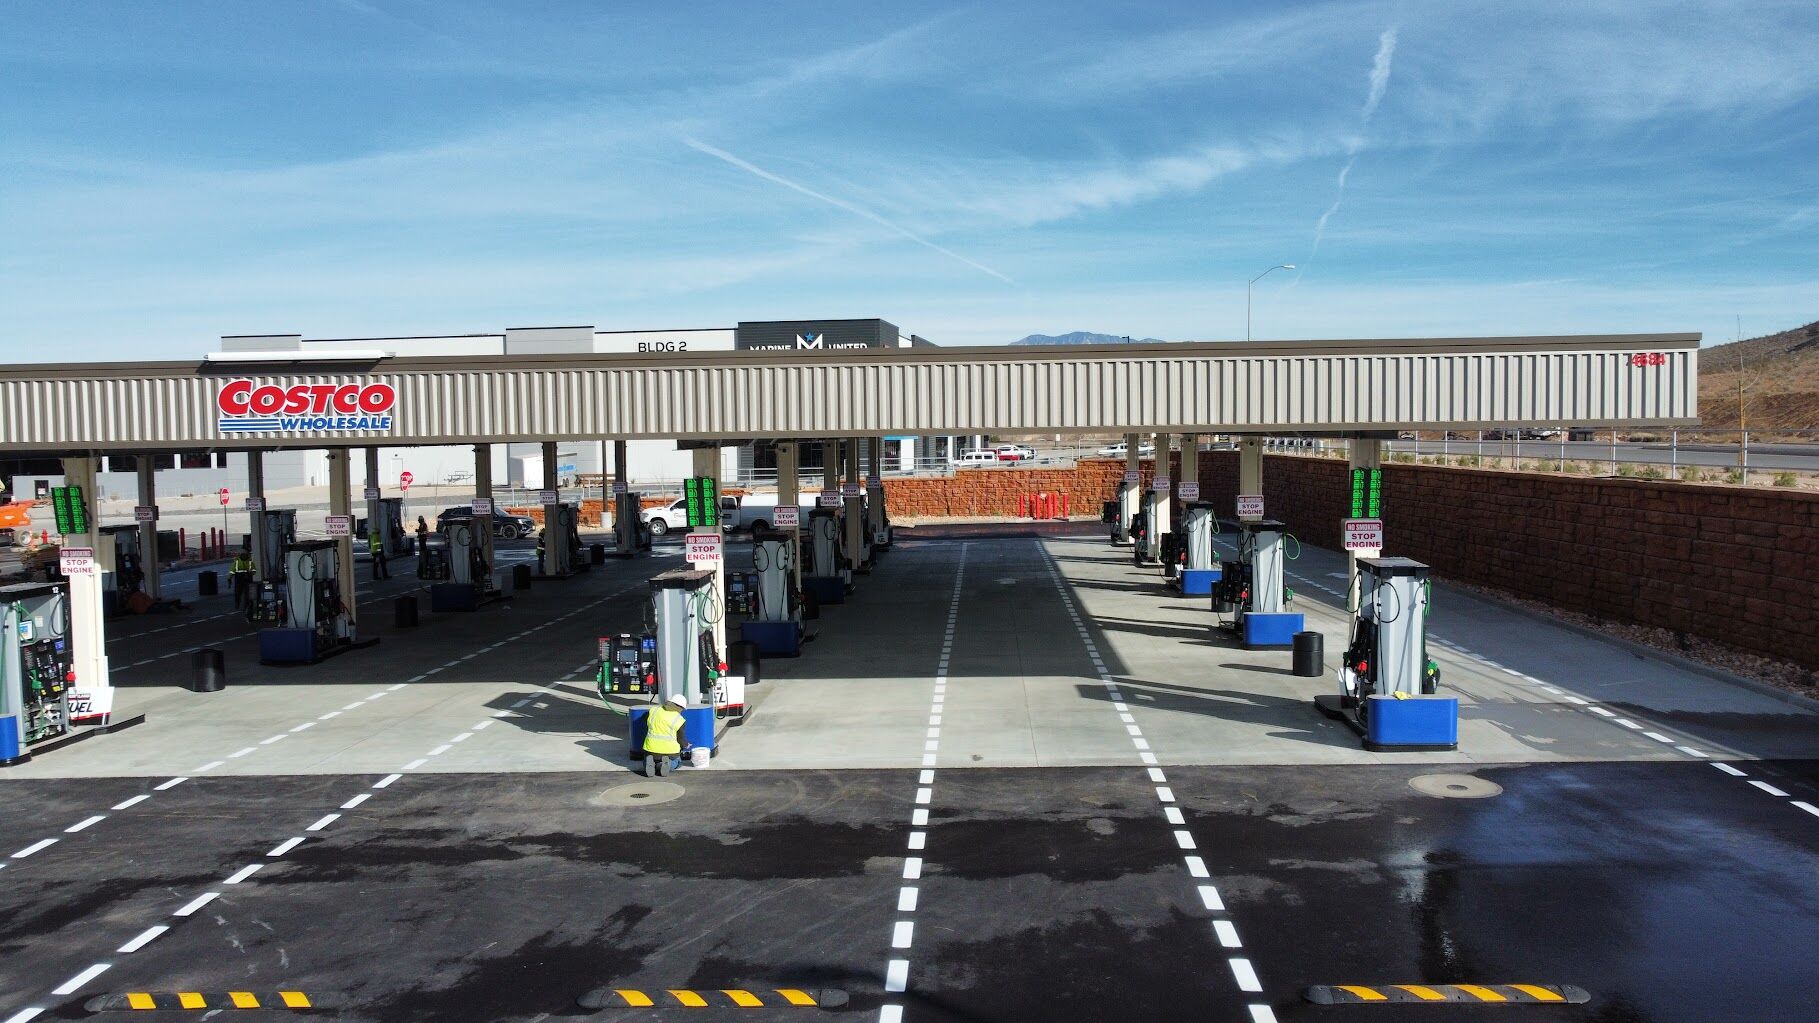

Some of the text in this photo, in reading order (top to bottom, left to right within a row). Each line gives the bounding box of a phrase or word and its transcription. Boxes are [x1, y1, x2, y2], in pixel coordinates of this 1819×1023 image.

[638, 341, 687, 352] BLDG 2
[218, 379, 395, 415] COSTCO
[280, 416, 392, 431] WHOLESALE
[1347, 523, 1381, 531] NO SMOKING
[68, 702, 93, 713] UEL
